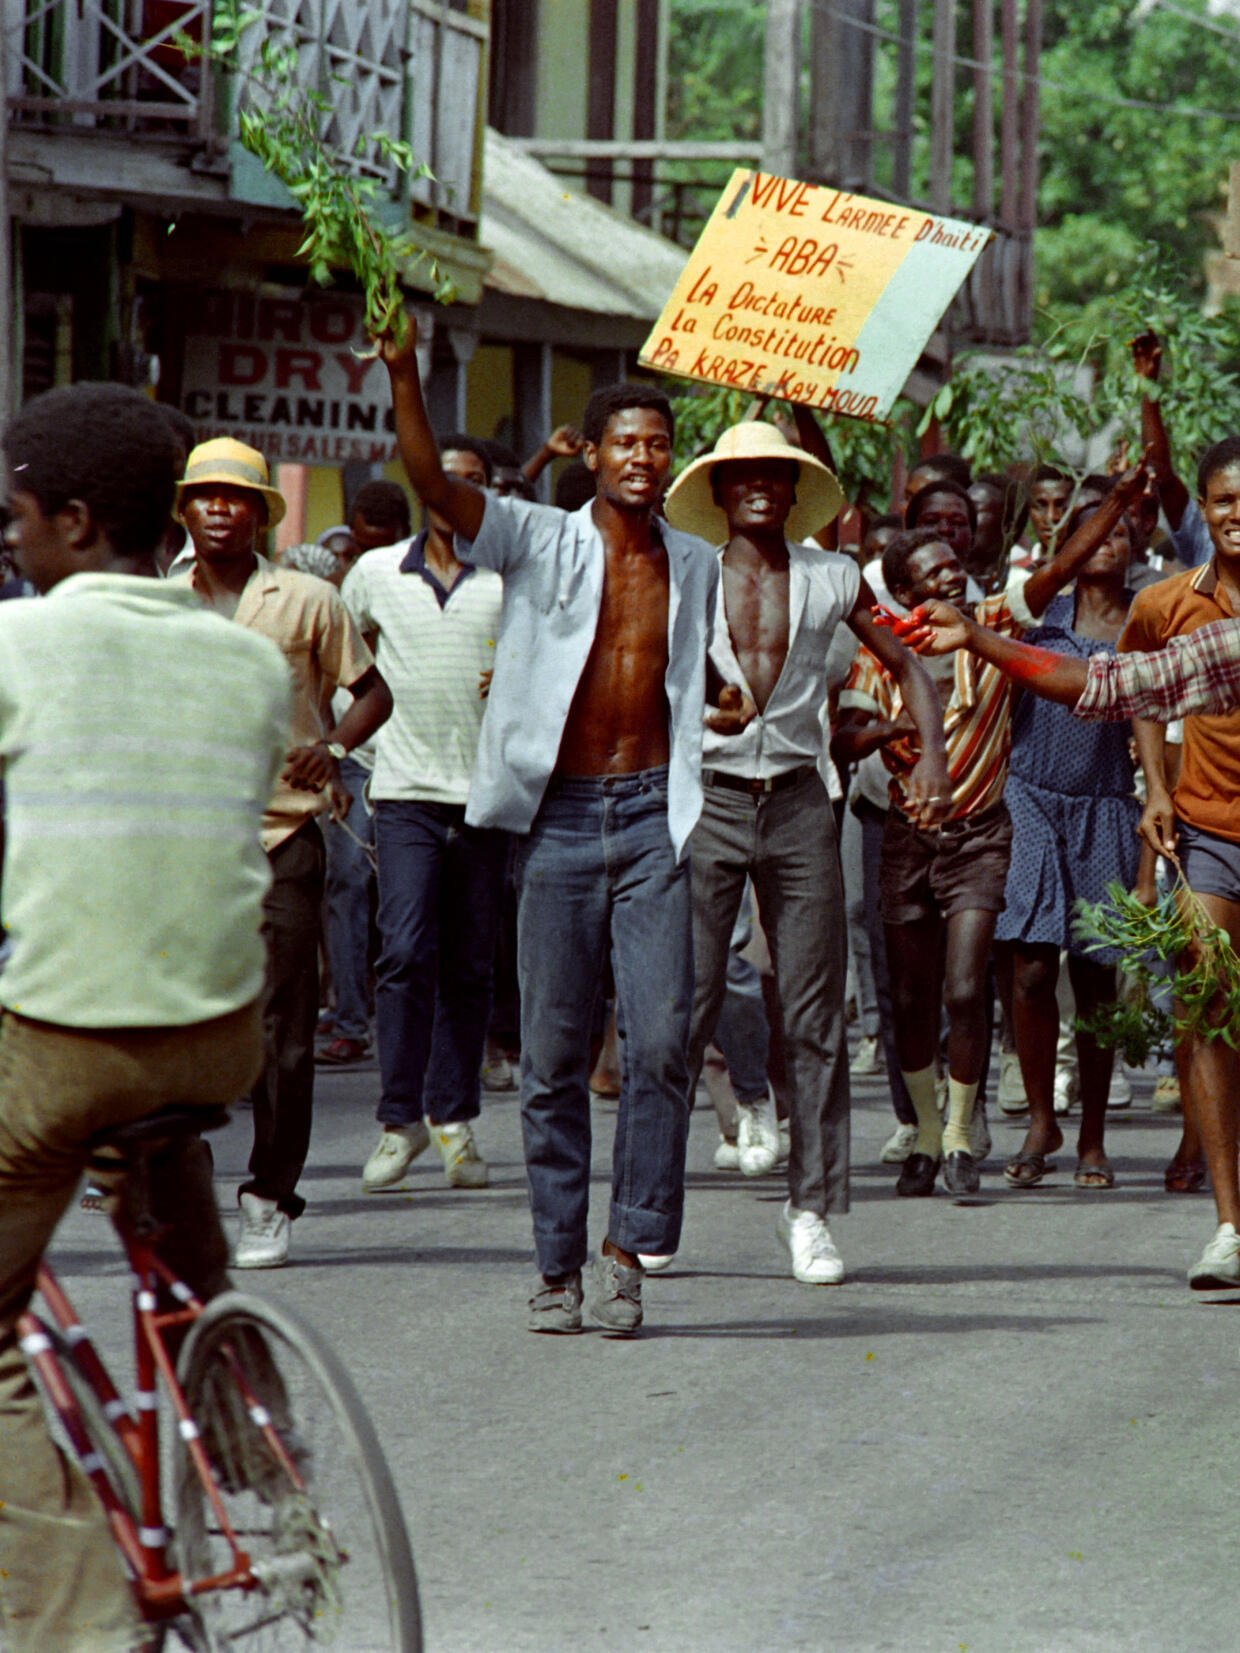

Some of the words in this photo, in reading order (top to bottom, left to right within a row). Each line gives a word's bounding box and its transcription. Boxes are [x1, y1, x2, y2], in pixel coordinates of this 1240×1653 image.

[751, 172, 819, 217] VIVE
[768, 237, 839, 277] ABA
[219, 343, 378, 394] DRY
